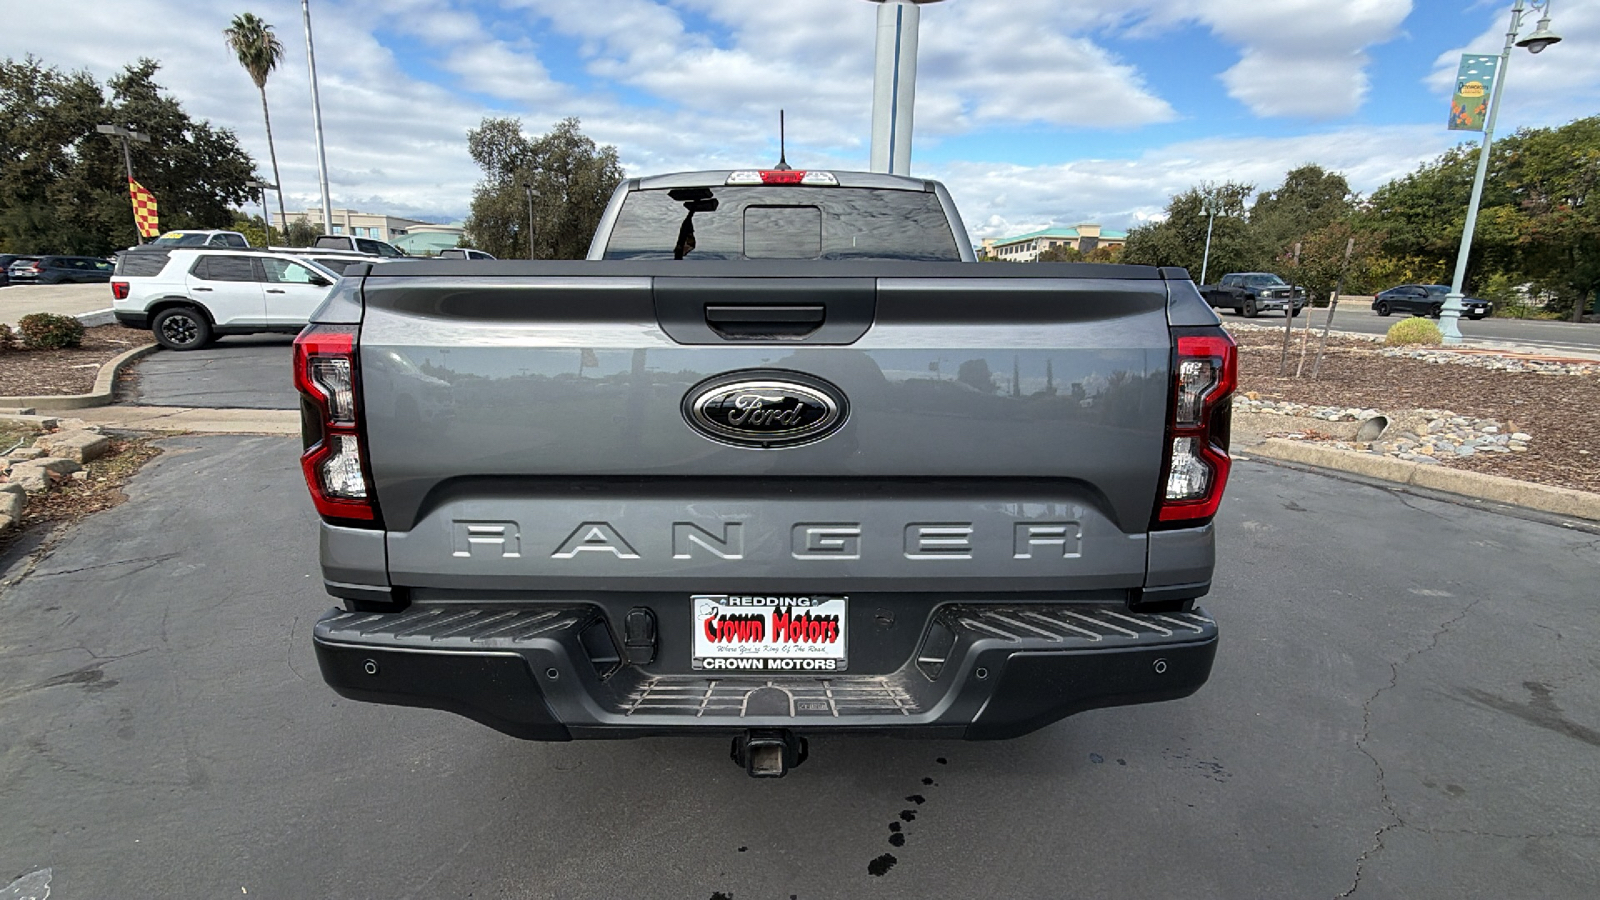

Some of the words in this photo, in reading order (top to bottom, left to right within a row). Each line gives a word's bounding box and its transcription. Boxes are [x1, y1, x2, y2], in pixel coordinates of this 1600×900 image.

[728, 394, 804, 426] Ford
[451, 519, 1083, 560] RANGER
[729, 597, 811, 607] REDDING
[704, 611, 765, 643] Crown
[772, 608, 839, 643] Motors
[763, 645, 779, 653] King
[808, 645, 826, 653] Road
[703, 658, 764, 669] CROWN
[768, 658, 836, 669] MOTORS
